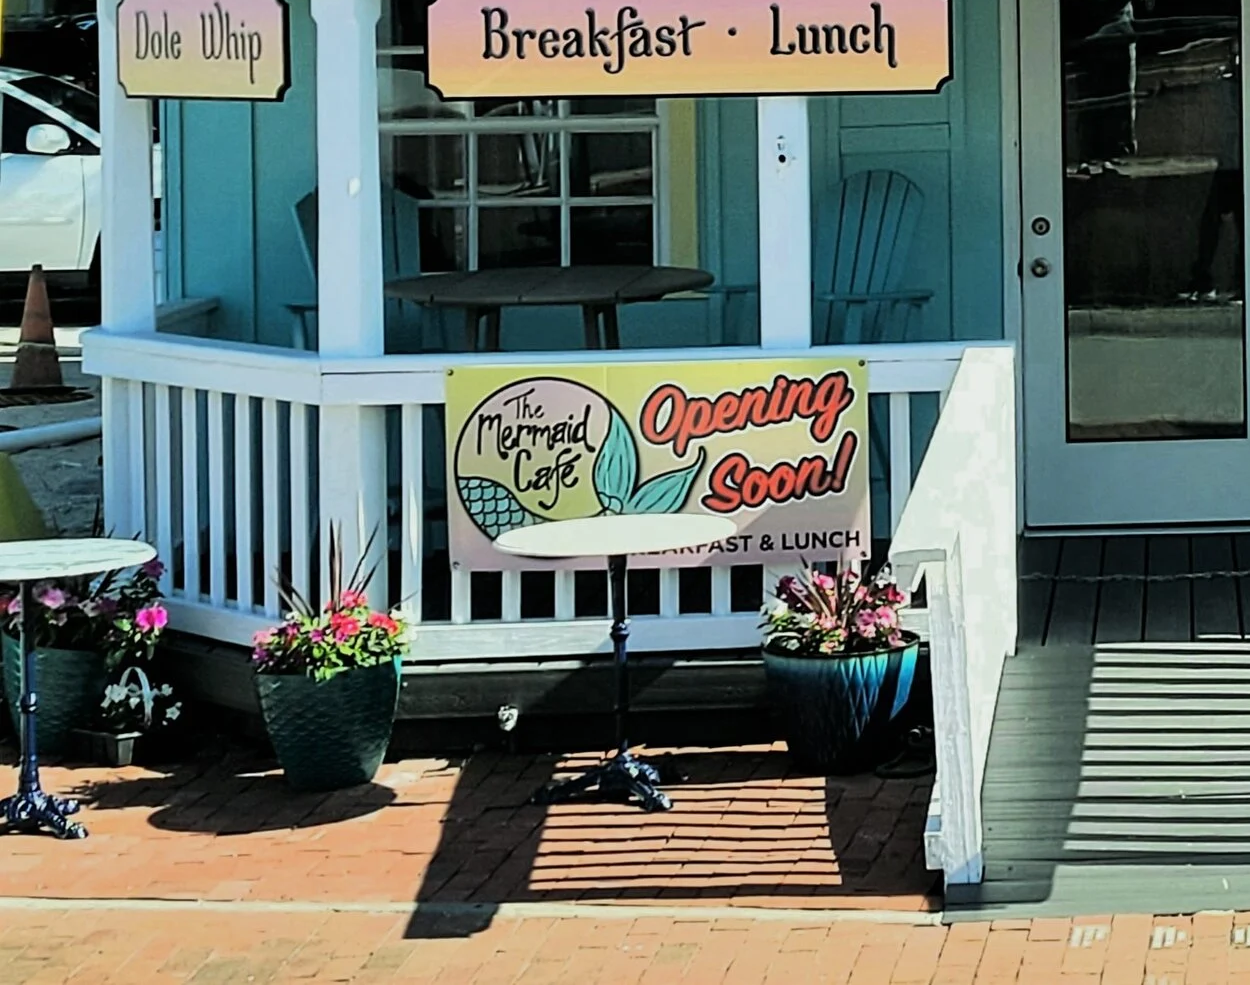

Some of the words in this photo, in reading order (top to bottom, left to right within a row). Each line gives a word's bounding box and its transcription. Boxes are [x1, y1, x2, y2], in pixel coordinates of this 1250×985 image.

[135, 10, 182, 60] Dole
[200, 0, 262, 85] Whip
[481, 6, 706, 75] Breakfast
[769, 1, 898, 69] Lunch
[476, 403, 596, 461] Mermaid
[503, 387, 545, 419] The
[640, 370, 855, 458] Opening
[701, 430, 858, 514] Soon!
[759, 533, 775, 552] &
[781, 530, 861, 552] LUNCH
